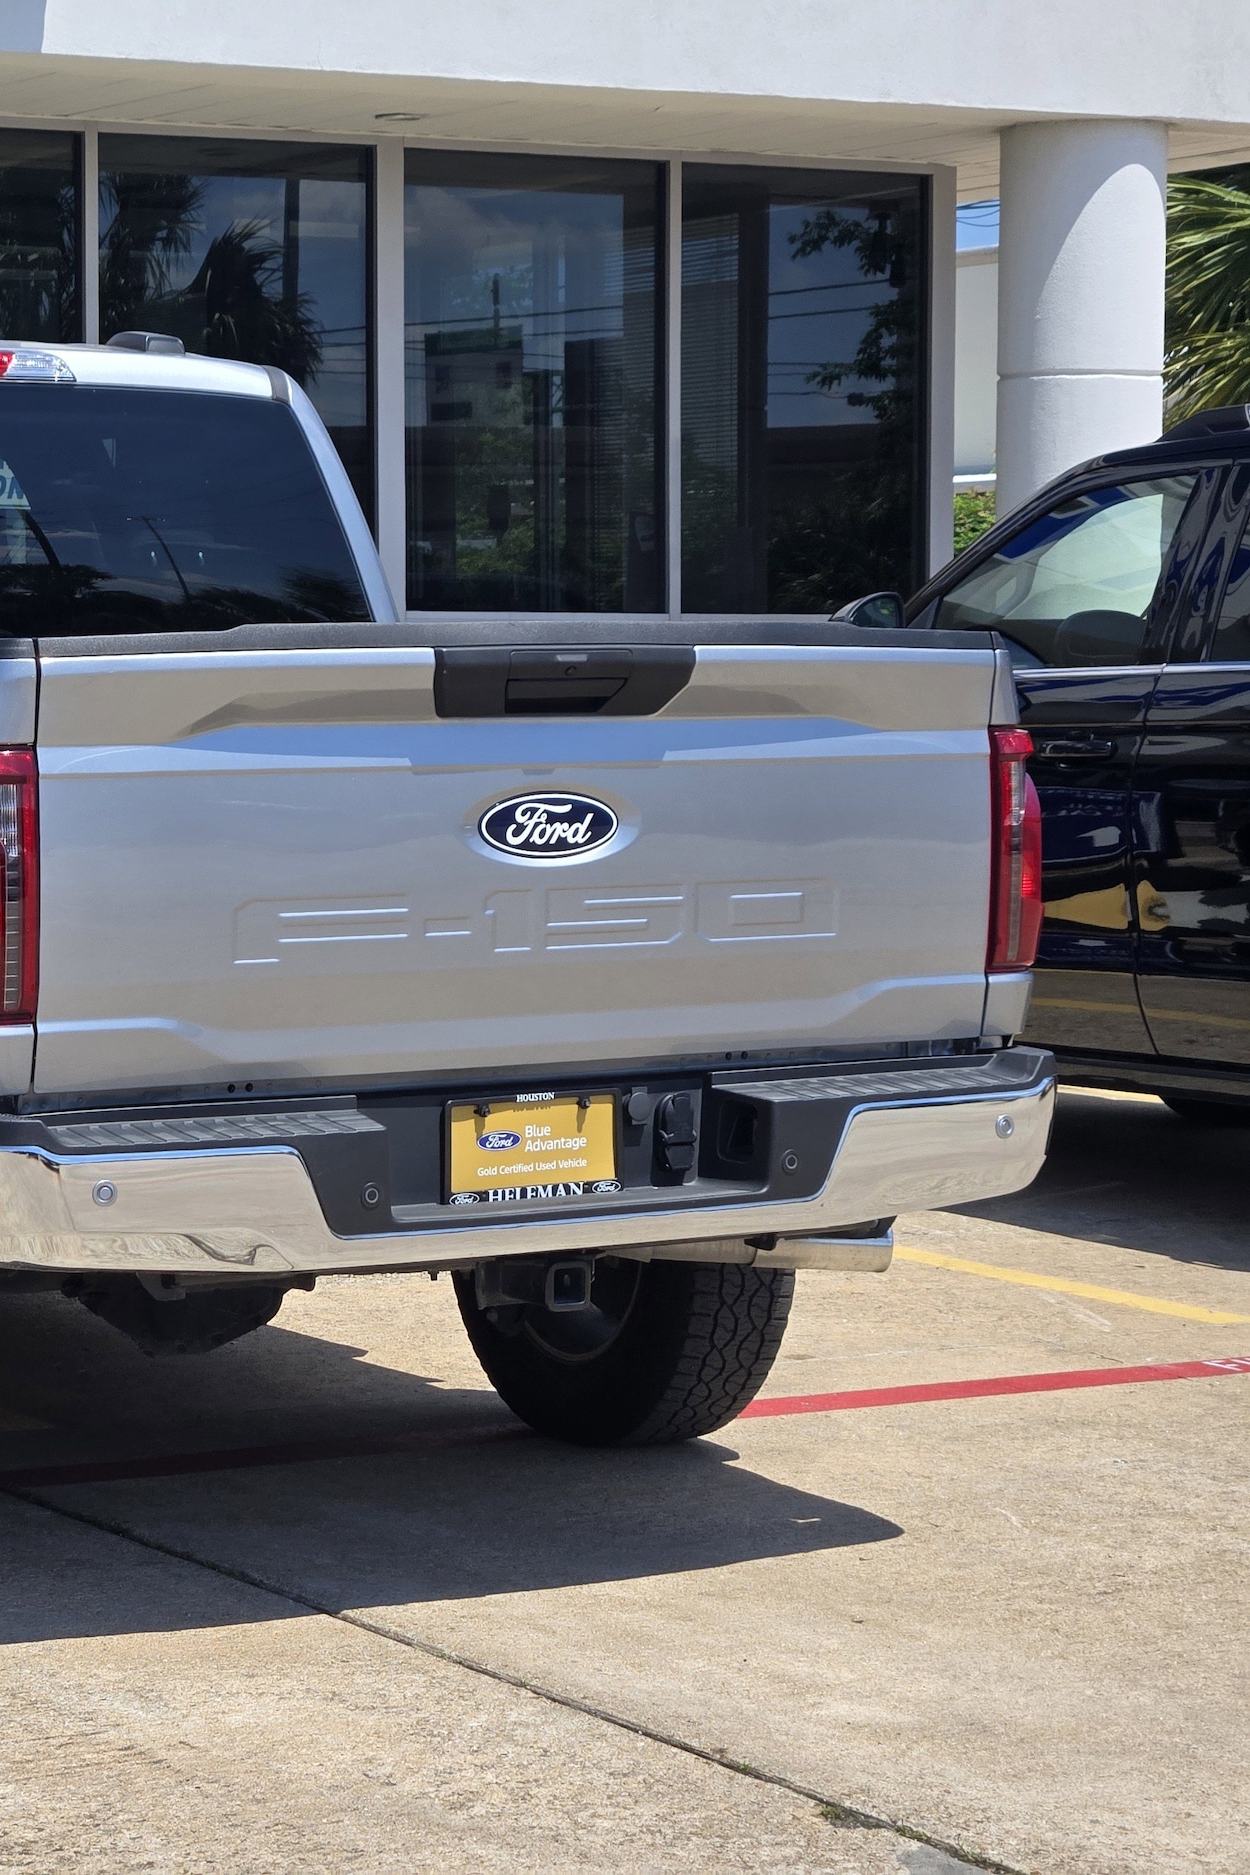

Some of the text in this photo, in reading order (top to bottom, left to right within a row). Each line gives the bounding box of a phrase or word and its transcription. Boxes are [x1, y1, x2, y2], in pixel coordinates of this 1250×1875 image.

[506, 802, 595, 845] Ford
[234, 879, 839, 963] F-150
[516, 1092, 555, 1103] HOUSTON
[524, 1125, 551, 1138] Blue
[485, 1133, 514, 1148] Ford
[524, 1136, 587, 1153] Advantage
[477, 1158, 588, 1177] Gold Certified Used Vehicle
[597, 1182, 616, 1192] Ford
[454, 1194, 475, 1205] Ford
